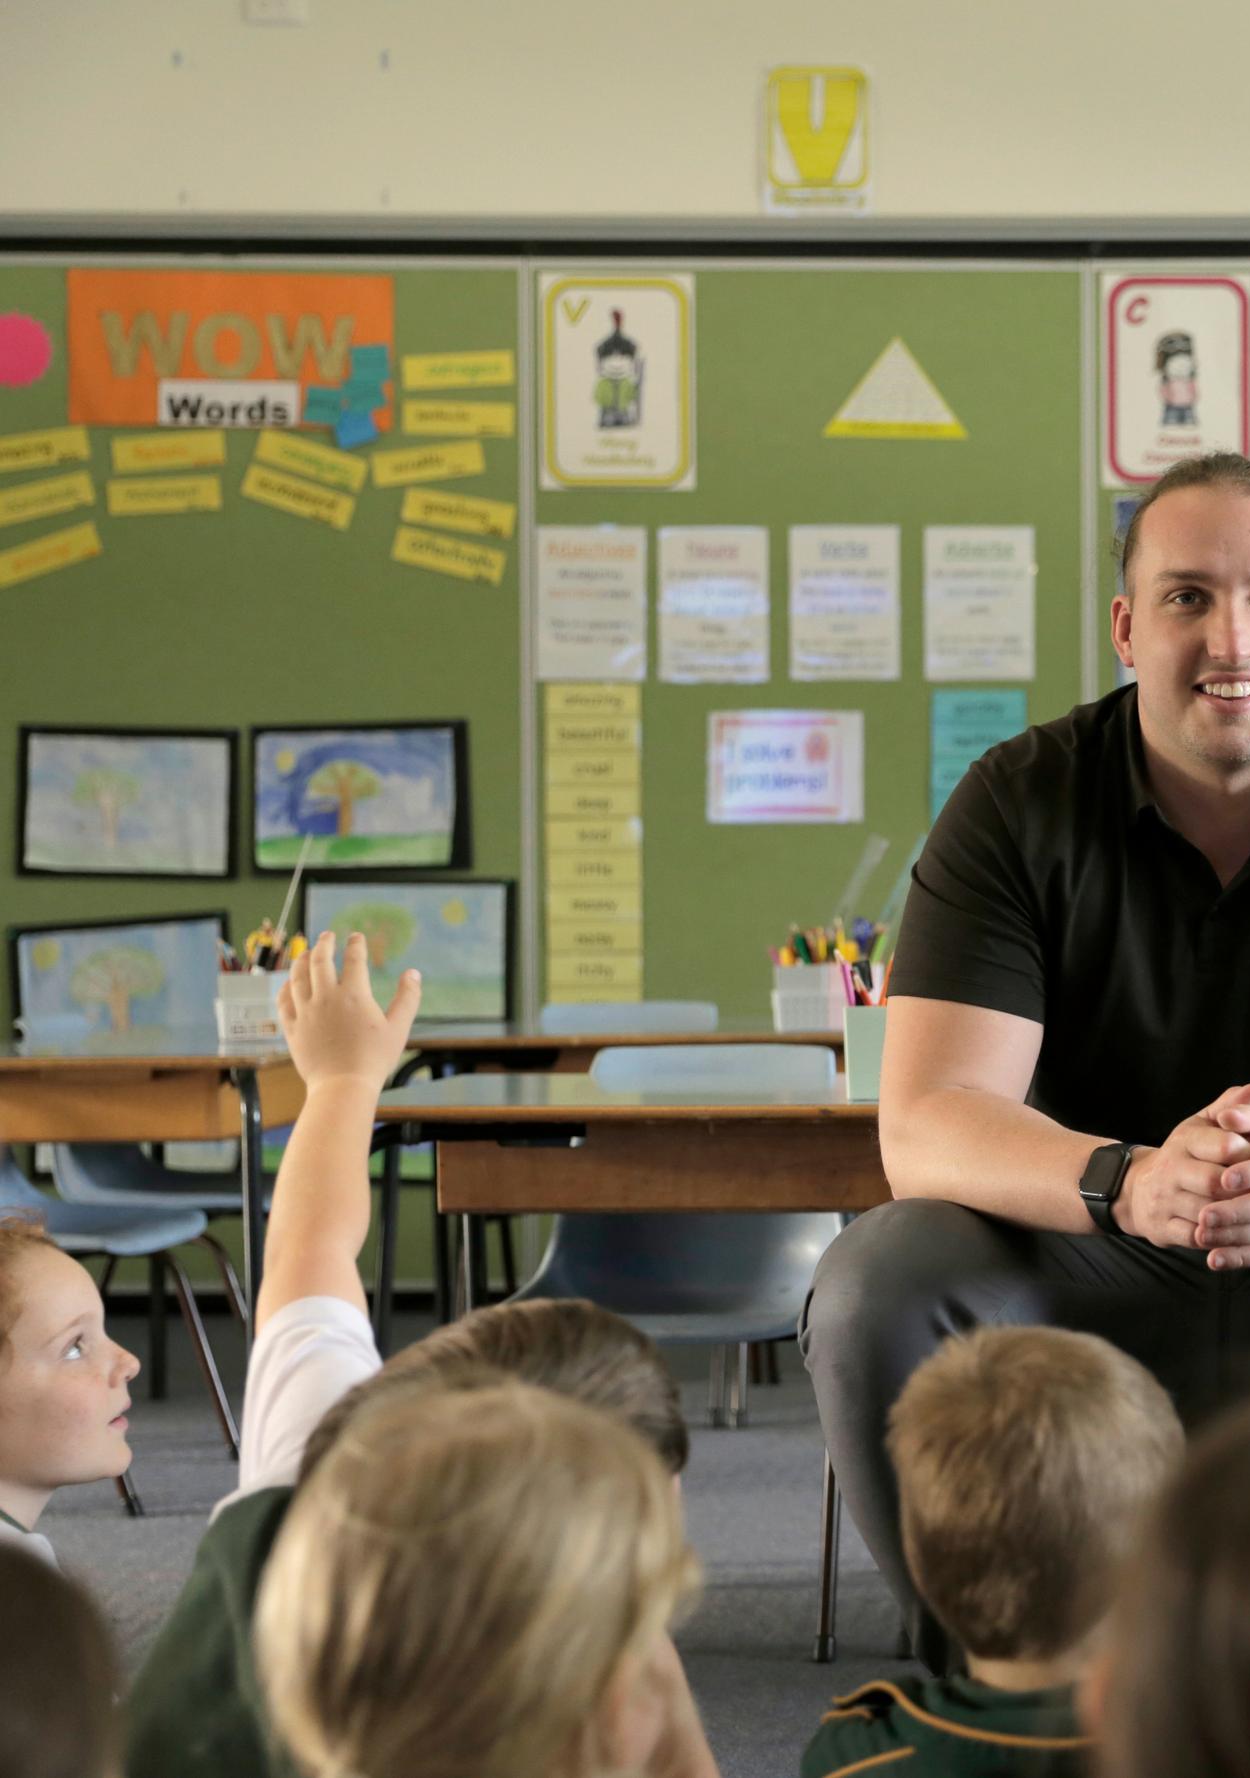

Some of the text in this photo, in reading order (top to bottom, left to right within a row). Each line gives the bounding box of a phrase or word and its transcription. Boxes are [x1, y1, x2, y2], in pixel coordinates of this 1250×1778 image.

[778, 77, 858, 184] V
[561, 297, 591, 326] V
[1126, 297, 1148, 324] C
[101, 309, 356, 380] WOW
[167, 394, 289, 425] Words
